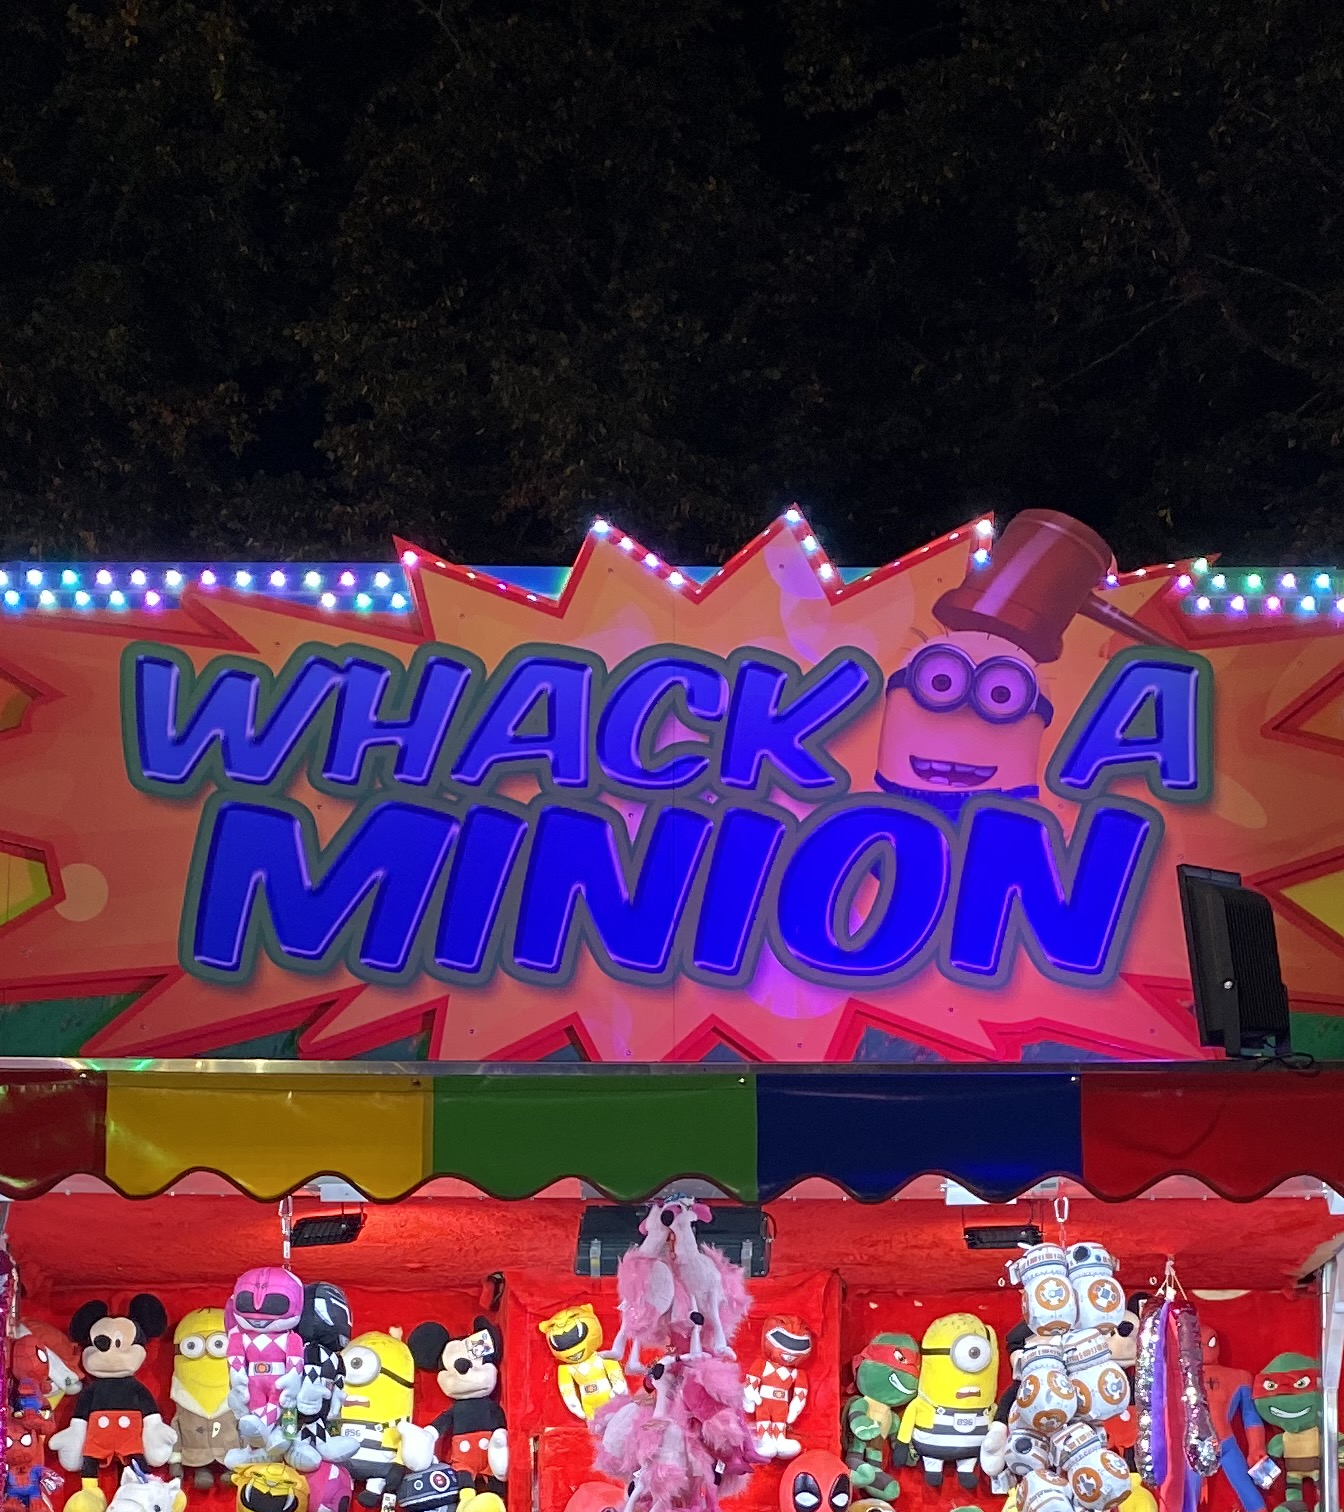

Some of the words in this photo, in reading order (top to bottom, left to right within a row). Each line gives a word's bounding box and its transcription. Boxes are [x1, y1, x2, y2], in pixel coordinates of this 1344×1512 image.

[130, 650, 874, 792] WHACK
[1052, 653, 1204, 790] A
[189, 800, 1153, 977] MINION
